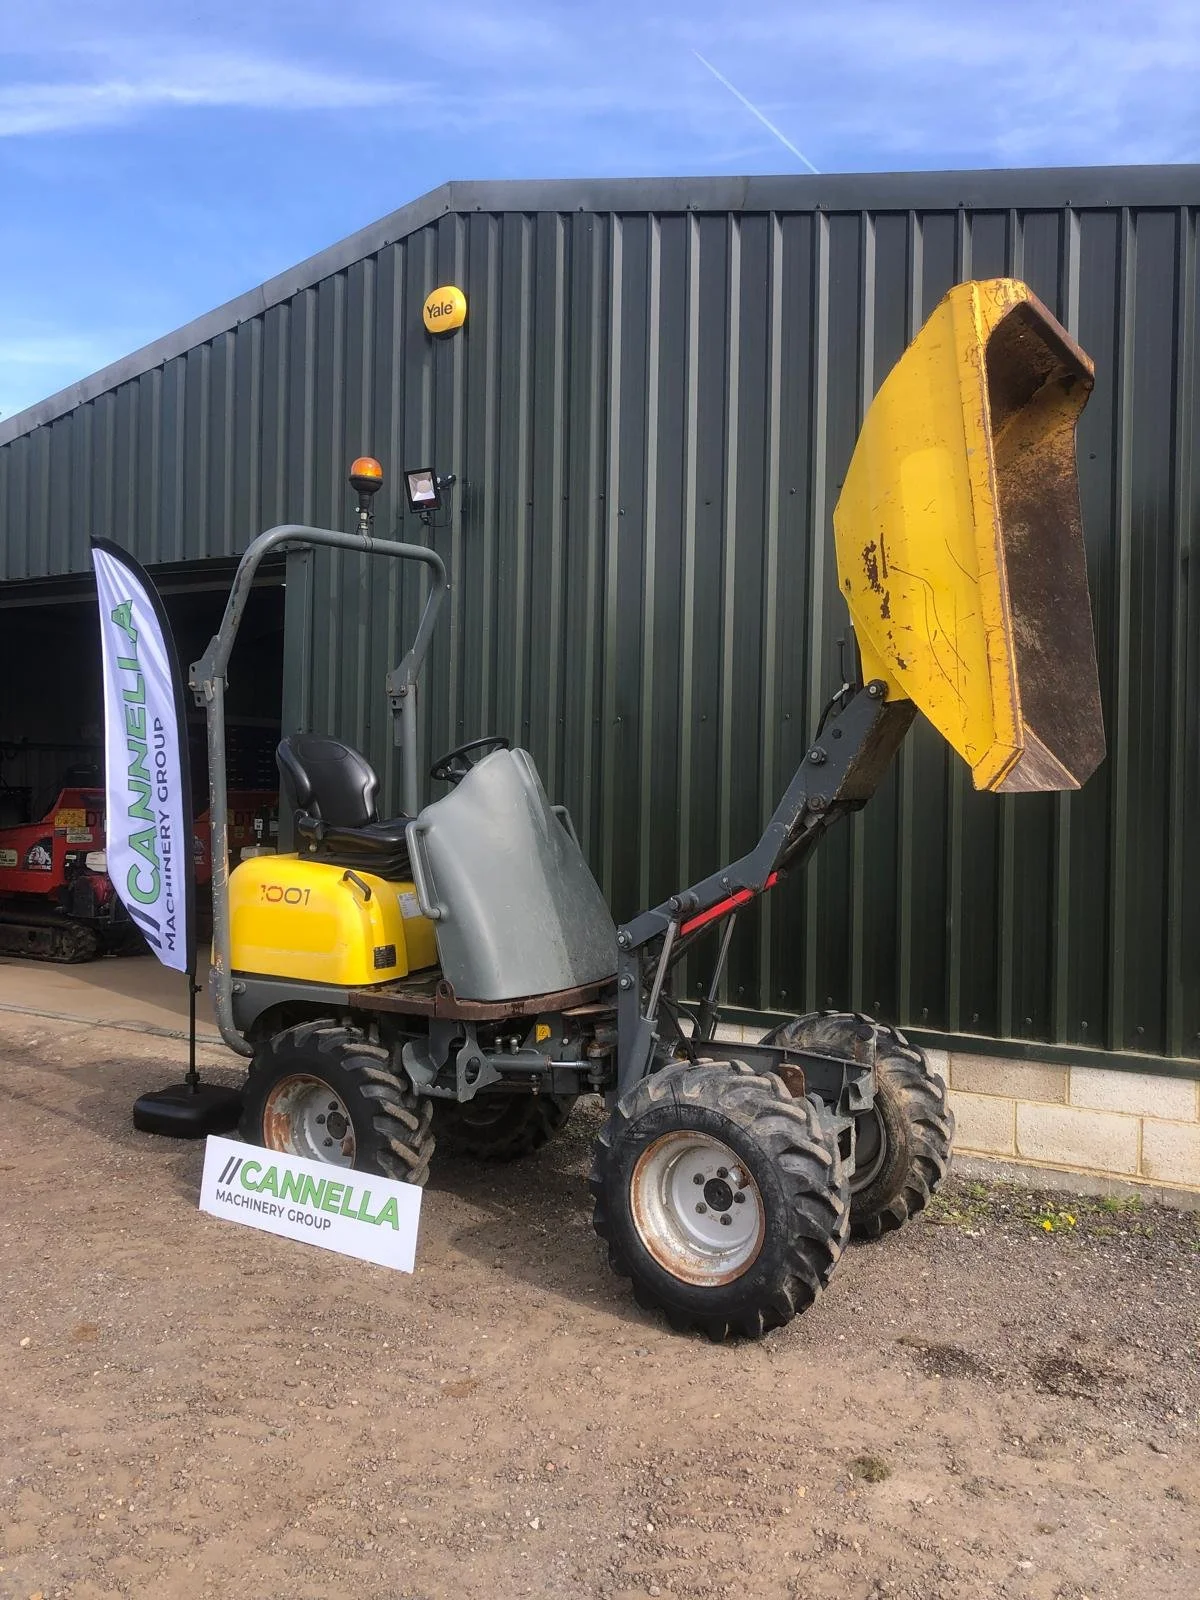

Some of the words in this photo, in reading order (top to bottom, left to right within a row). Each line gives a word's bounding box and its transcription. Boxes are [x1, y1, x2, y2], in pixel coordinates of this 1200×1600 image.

[427, 302, 453, 319] Yale
[153, 716, 170, 803] GROUP
[157, 809, 176, 952] MACHINERY
[215, 1188, 285, 1219] MACHINERY
[287, 1209, 332, 1231] GROUP
